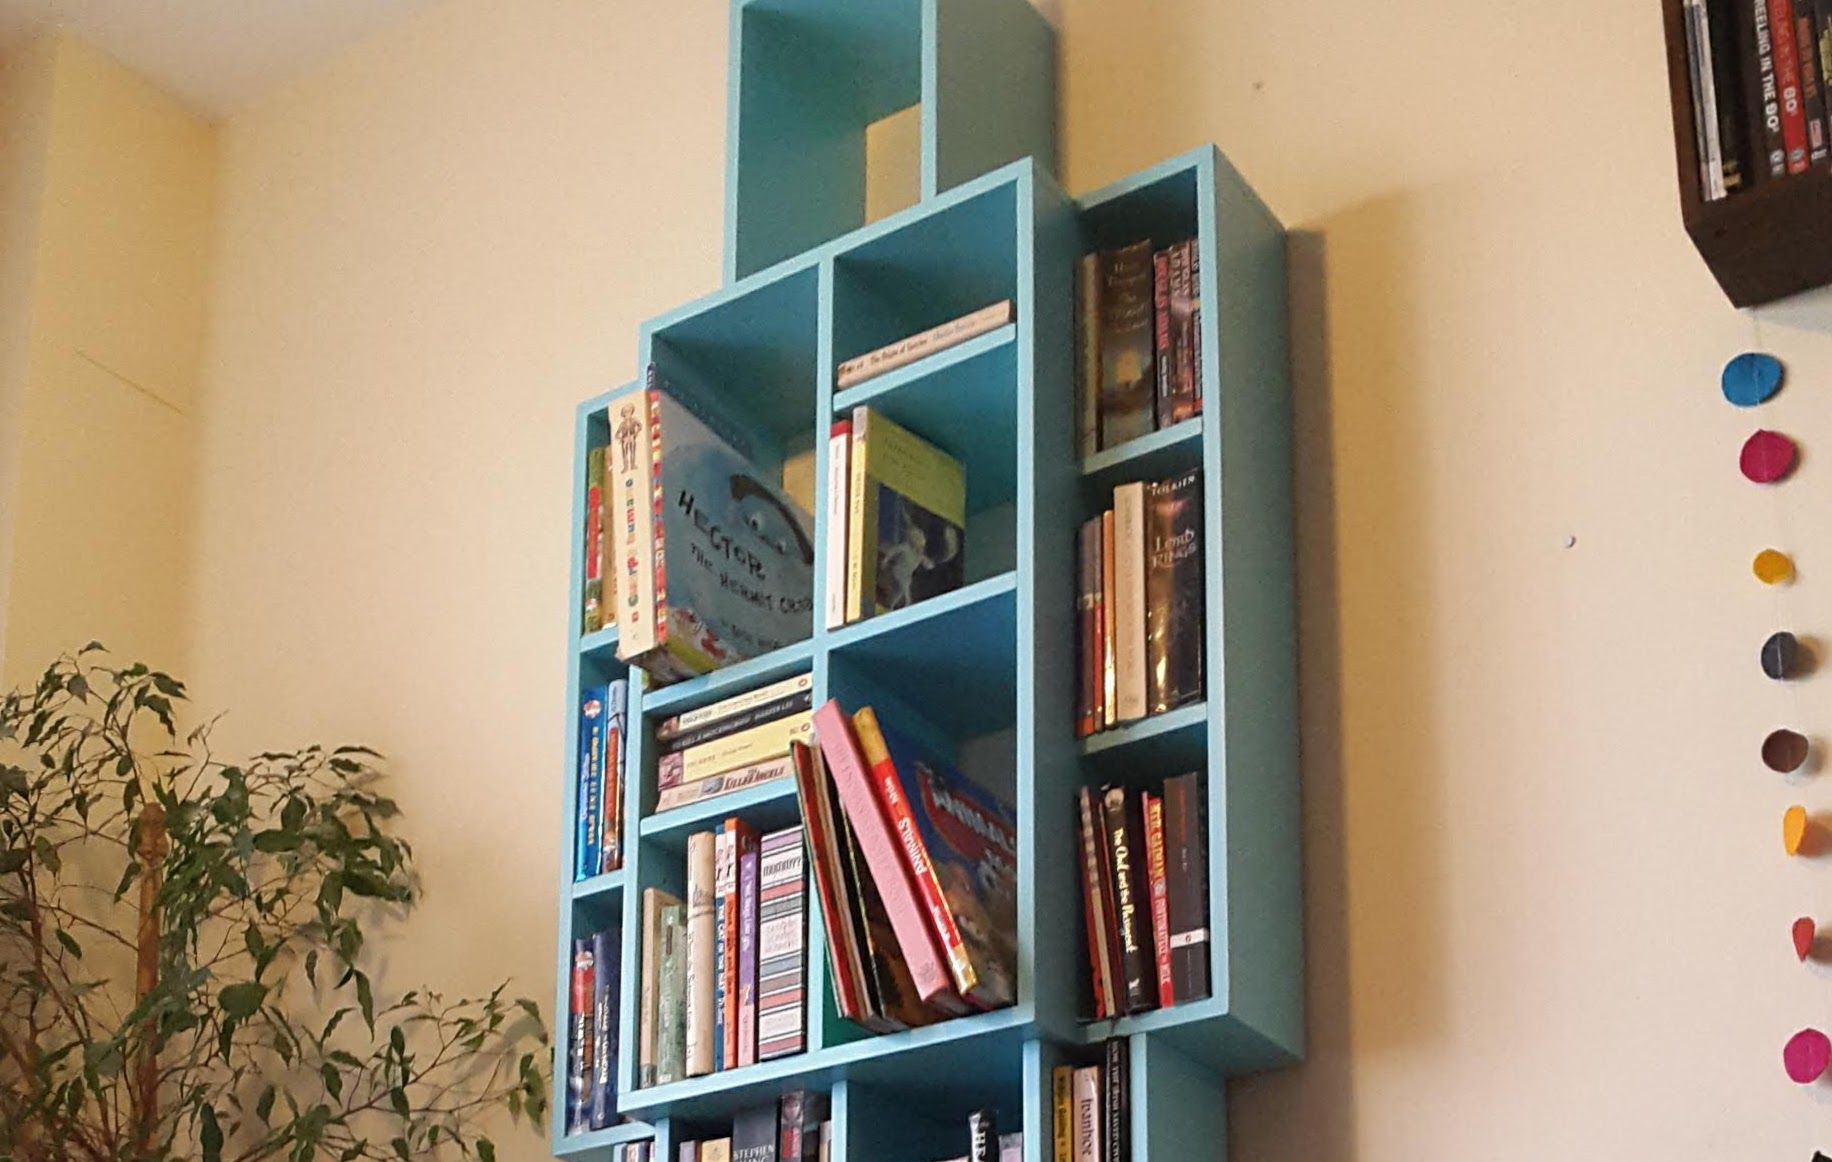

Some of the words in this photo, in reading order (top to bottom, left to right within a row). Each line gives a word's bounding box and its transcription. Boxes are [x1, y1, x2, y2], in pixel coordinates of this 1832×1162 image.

[1760, 55, 1772, 72] IN
[1762, 72, 1776, 101] THE
[678, 490, 765, 581] HECTOR
[900, 817, 927, 876] ANIMALS
[733, 1144, 775, 1161] STEPHEN
